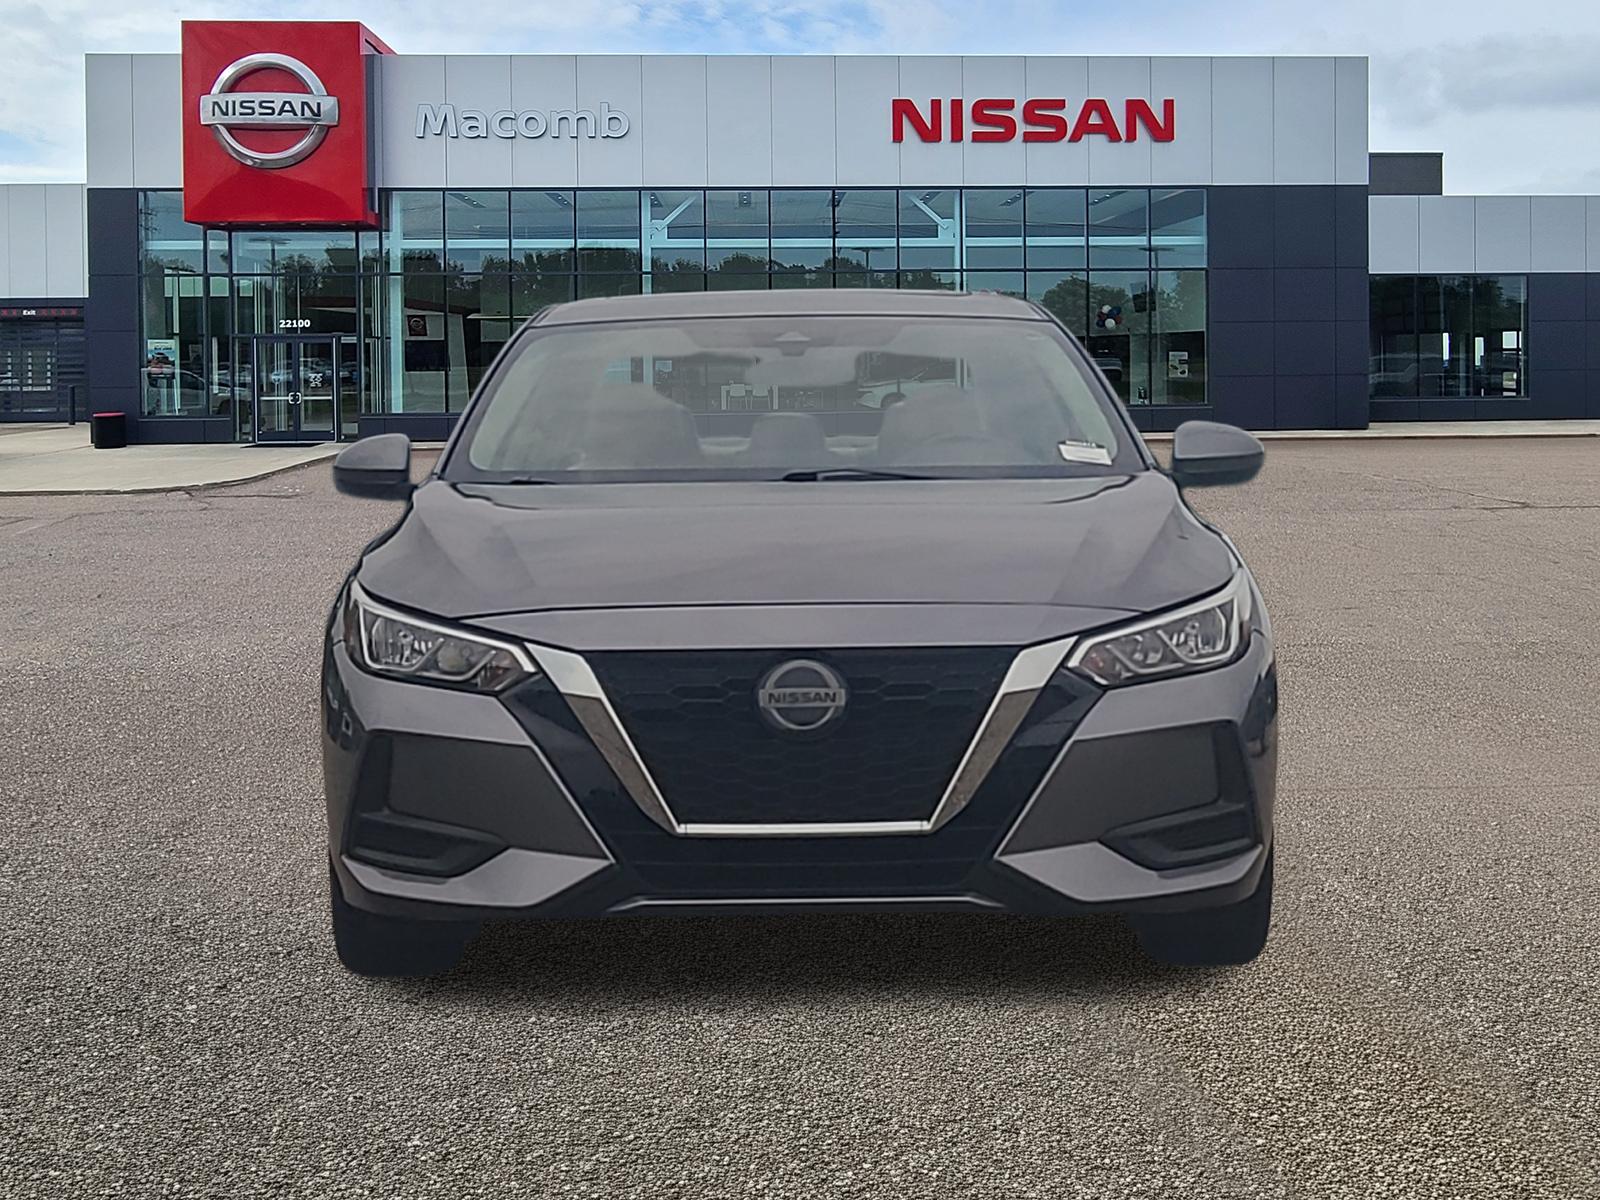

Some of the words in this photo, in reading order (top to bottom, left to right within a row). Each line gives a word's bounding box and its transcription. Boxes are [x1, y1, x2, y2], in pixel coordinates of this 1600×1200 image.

[212, 100, 321, 117] NISSAN
[415, 102, 630, 138] Macomb
[892, 98, 1175, 143] NISSAN
[279, 319, 311, 328] 22100
[768, 692, 837, 704] NISSAN
